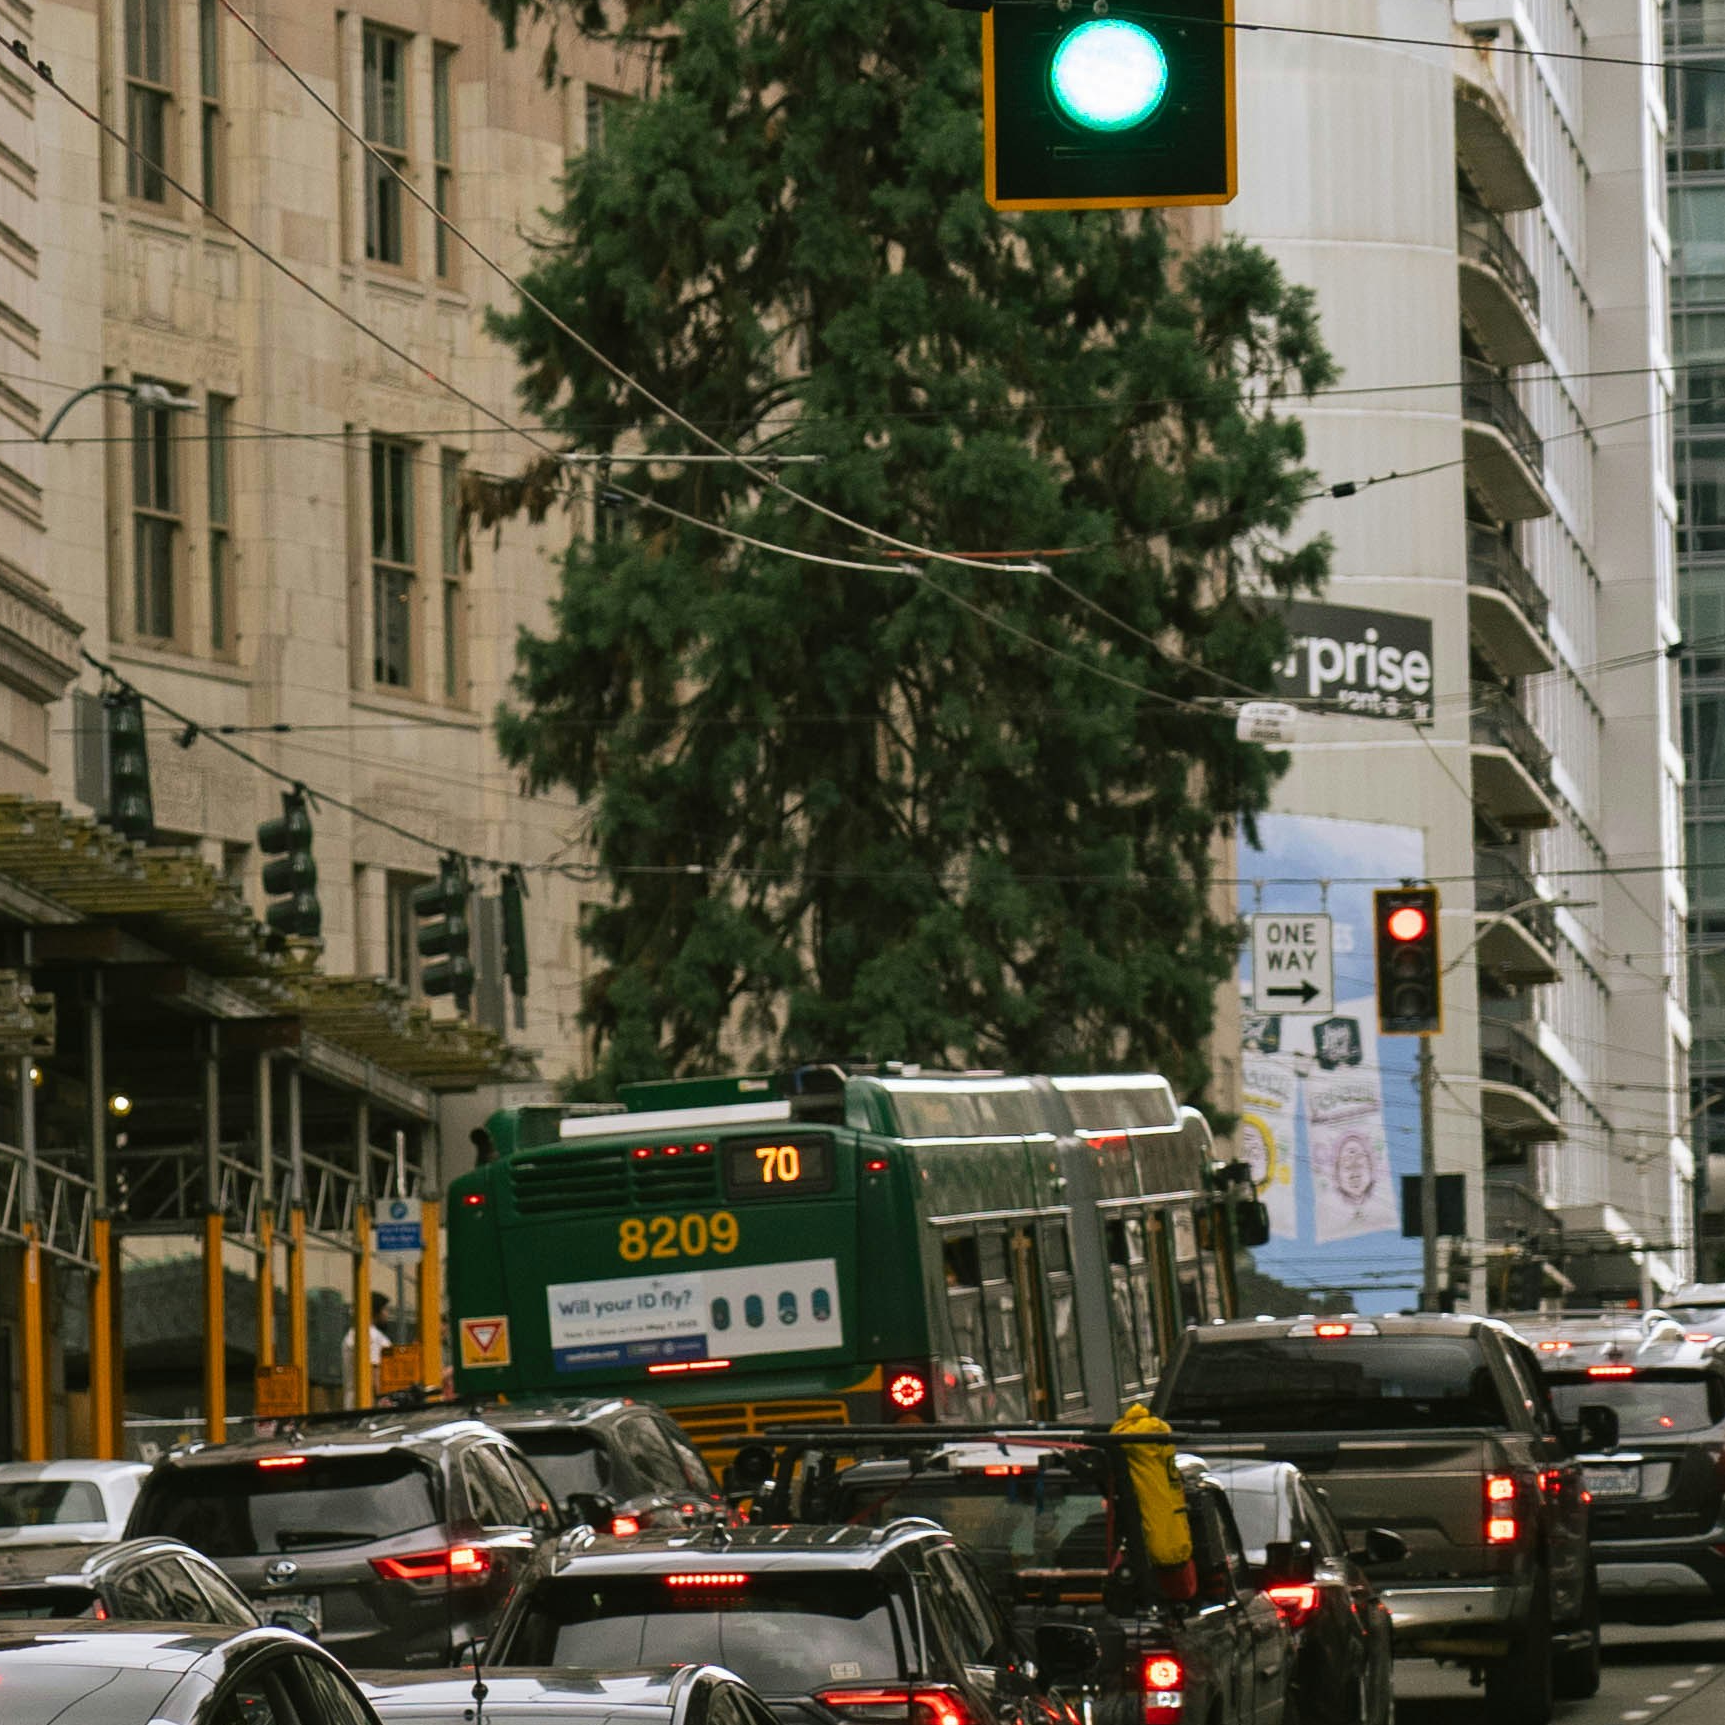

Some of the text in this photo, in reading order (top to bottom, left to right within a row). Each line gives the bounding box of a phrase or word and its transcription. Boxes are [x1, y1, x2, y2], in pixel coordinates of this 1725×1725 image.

[1272, 627, 1431, 697] rprise
[1266, 922, 1317, 945] ONE
[1266, 950, 1317, 971] WAY
[756, 1145, 800, 1183] 70
[619, 1211, 739, 1261] 8209
[558, 1289, 692, 1318] Will your ID fly?
